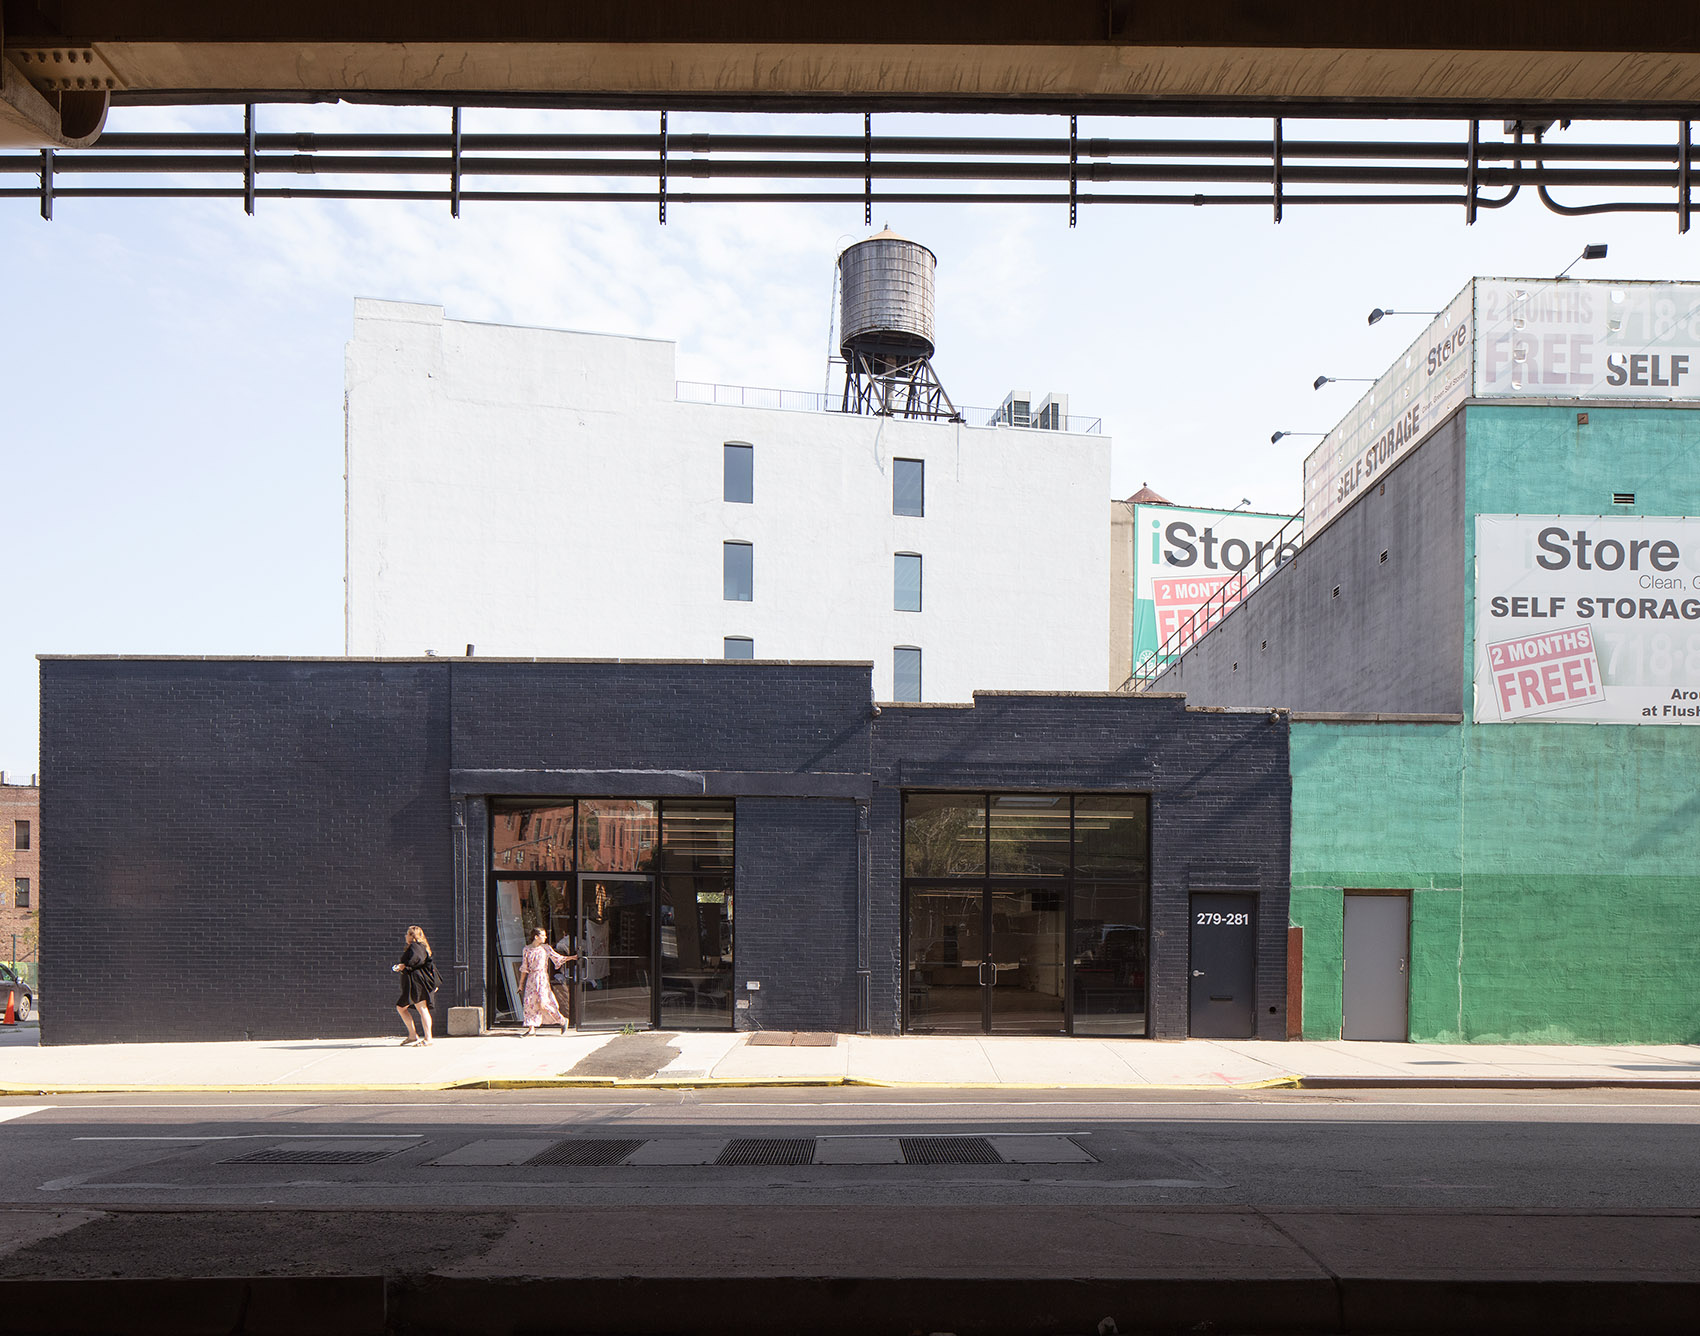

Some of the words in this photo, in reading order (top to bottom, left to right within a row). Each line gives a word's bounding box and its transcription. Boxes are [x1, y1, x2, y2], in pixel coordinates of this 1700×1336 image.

[1487, 289, 1499, 322] 2
[1486, 332, 1594, 385] FREE
[1606, 352, 1690, 387] SELF
[1337, 465, 1362, 503] SELF
[1366, 403, 1421, 478] STORAGE
[1151, 519, 1299, 573] iStore
[1161, 584, 1171, 599] 2
[1175, 580, 1241, 599] MONTHS
[1639, 574, 1687, 591] Clean,
[1490, 596, 1566, 618] SELF
[1576, 597, 1700, 620] STORAG
[1158, 606, 1235, 649] FRE
[1491, 648, 1504, 665] 2
[1508, 630, 1590, 662] MONTHS
[1498, 657, 1597, 713] FREE!
[1670, 688, 1700, 700] Aro
[1641, 705, 1657, 717] at
[1196, 912, 1249, 926] 279-281
